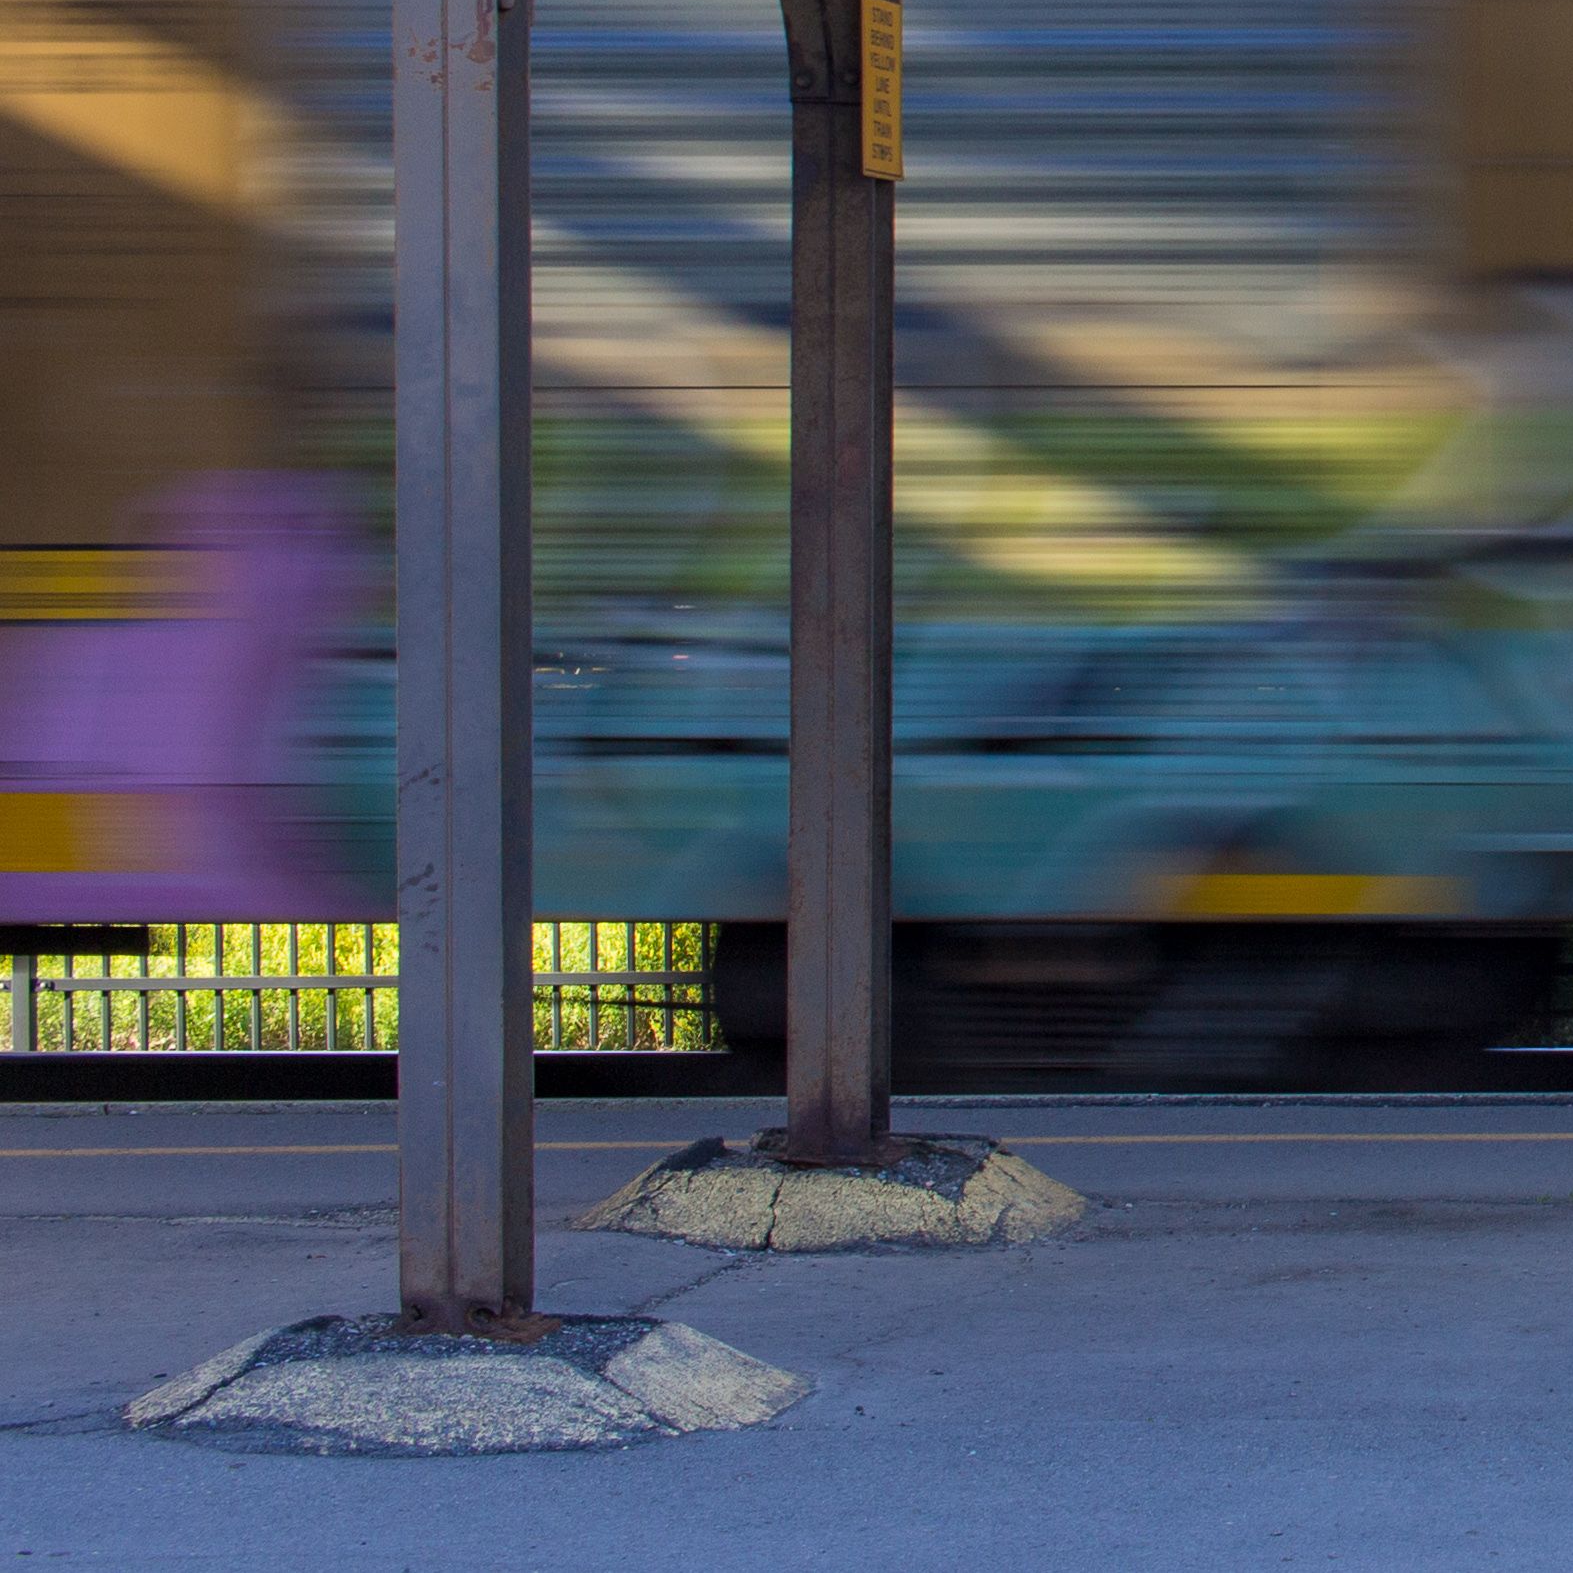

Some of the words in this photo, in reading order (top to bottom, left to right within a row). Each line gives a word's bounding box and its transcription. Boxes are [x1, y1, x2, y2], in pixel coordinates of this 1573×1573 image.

[872, 7, 893, 27] STAND
[870, 51, 897, 73] YELLOW
[876, 76, 890, 94] LINE
[872, 142, 893, 162] STOPS
